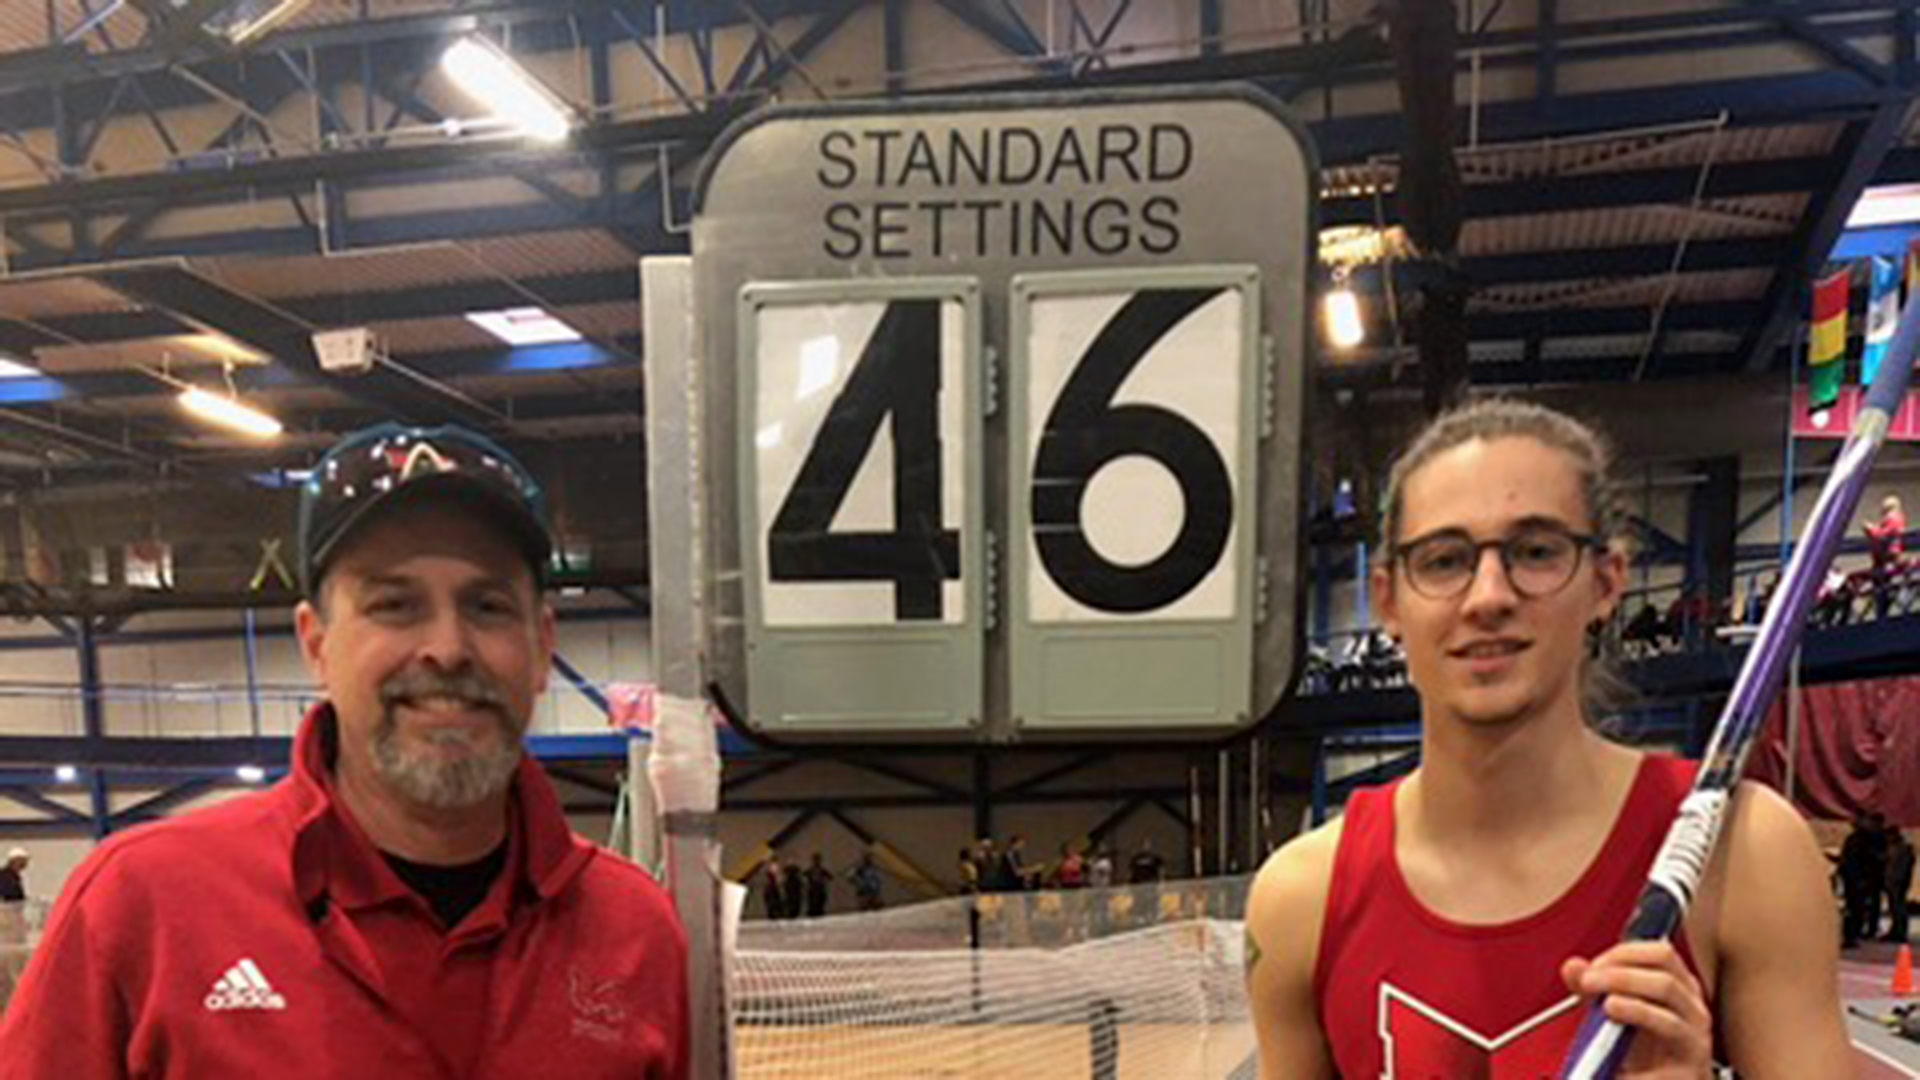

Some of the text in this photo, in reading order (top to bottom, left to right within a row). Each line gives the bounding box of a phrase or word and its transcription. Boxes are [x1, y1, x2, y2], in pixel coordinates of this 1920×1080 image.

[817, 123, 1193, 189] STANDARD
[822, 196, 1181, 260] SETTINGS
[204, 987, 286, 1011] adidas
